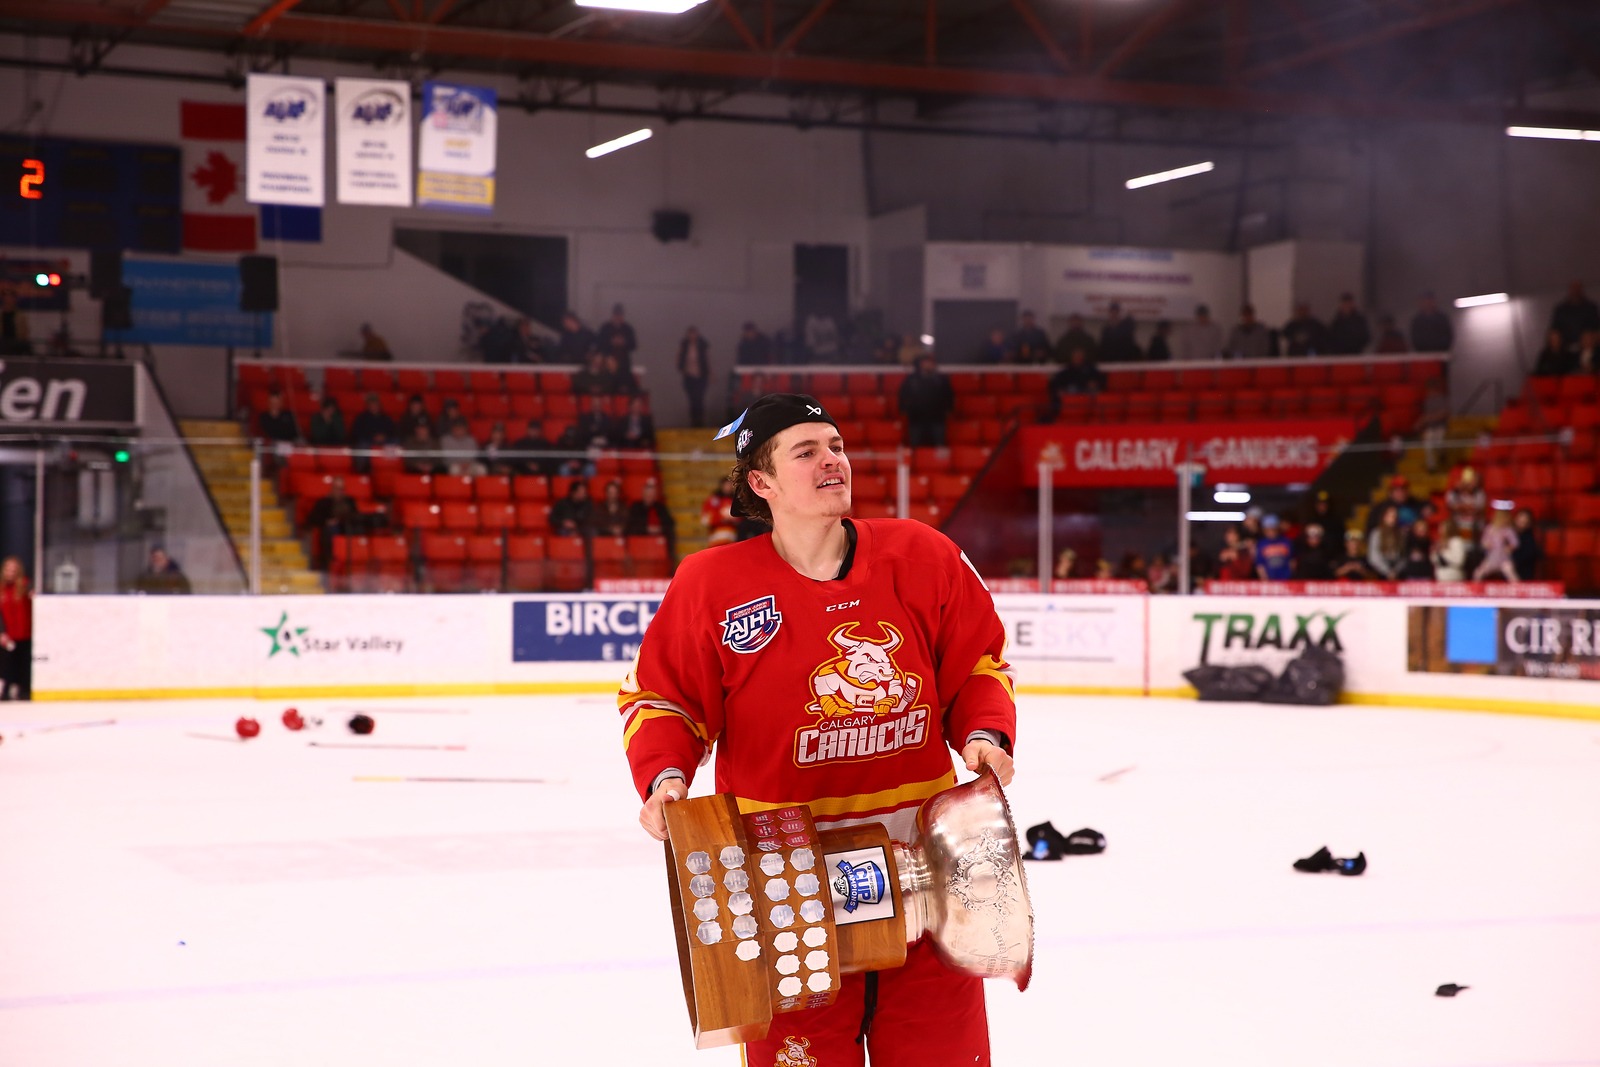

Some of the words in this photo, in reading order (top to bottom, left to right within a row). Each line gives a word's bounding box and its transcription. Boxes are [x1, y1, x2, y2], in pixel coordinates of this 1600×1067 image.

[20, 158, 45, 199] 2
[0, 358, 87, 420] en
[1074, 438, 1178, 471] CALGARY
[1207, 435, 1319, 469] CANUCKS
[727, 608, 779, 640] AJHL
[825, 599, 861, 612] CCM
[302, 637, 340, 651] Star
[346, 636, 404, 654] Valley
[1192, 610, 1350, 664] TRAXX
[1505, 616, 1563, 654] CIR
[797, 709, 927, 763] CANUCKS
[819, 714, 877, 731] CALGARY
[843, 865, 857, 907] CHAMPIONS
[853, 867, 871, 901] CUP
